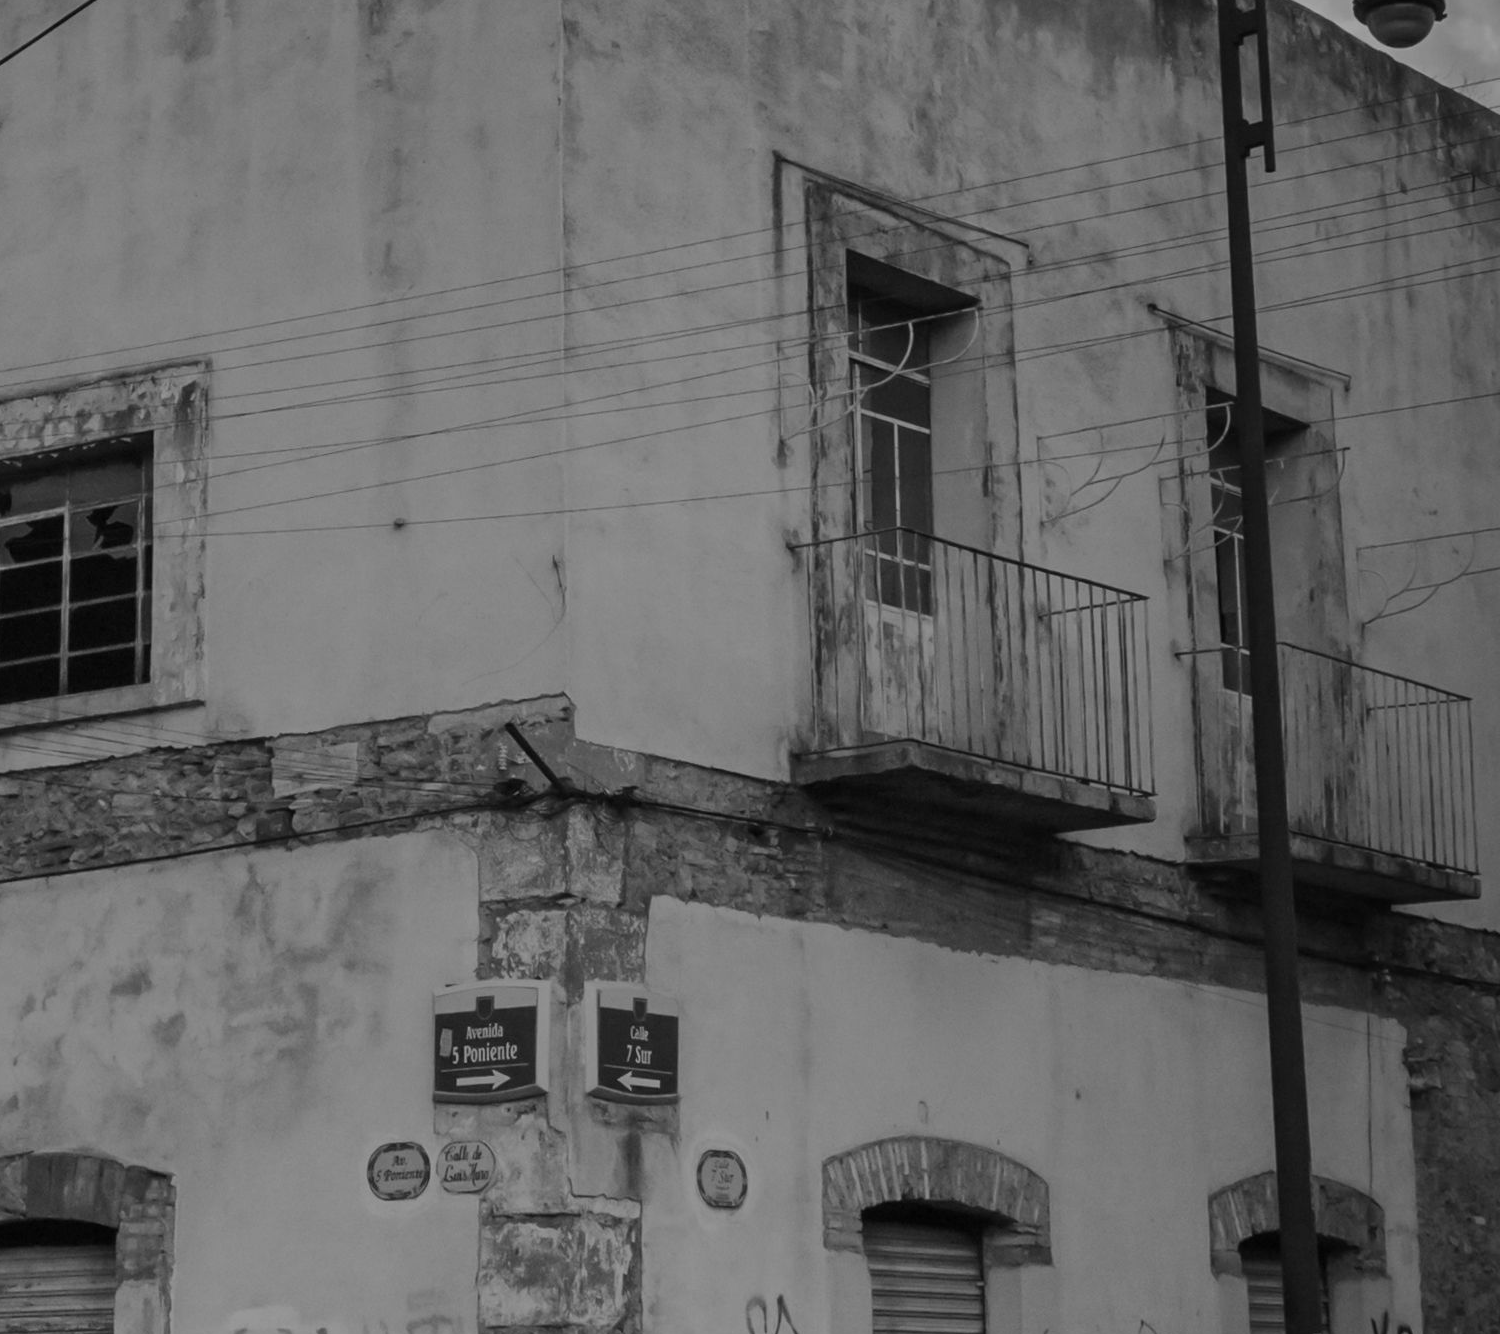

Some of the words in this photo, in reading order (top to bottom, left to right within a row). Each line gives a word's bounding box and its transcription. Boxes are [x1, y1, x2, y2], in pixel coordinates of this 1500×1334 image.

[466, 1023, 503, 1041] Avenida
[630, 1025, 649, 1042] Calle
[452, 1046, 460, 1064] 5
[464, 1042, 518, 1064] Poniente
[626, 1045, 633, 1062] 7
[635, 1046, 652, 1065] Sur
